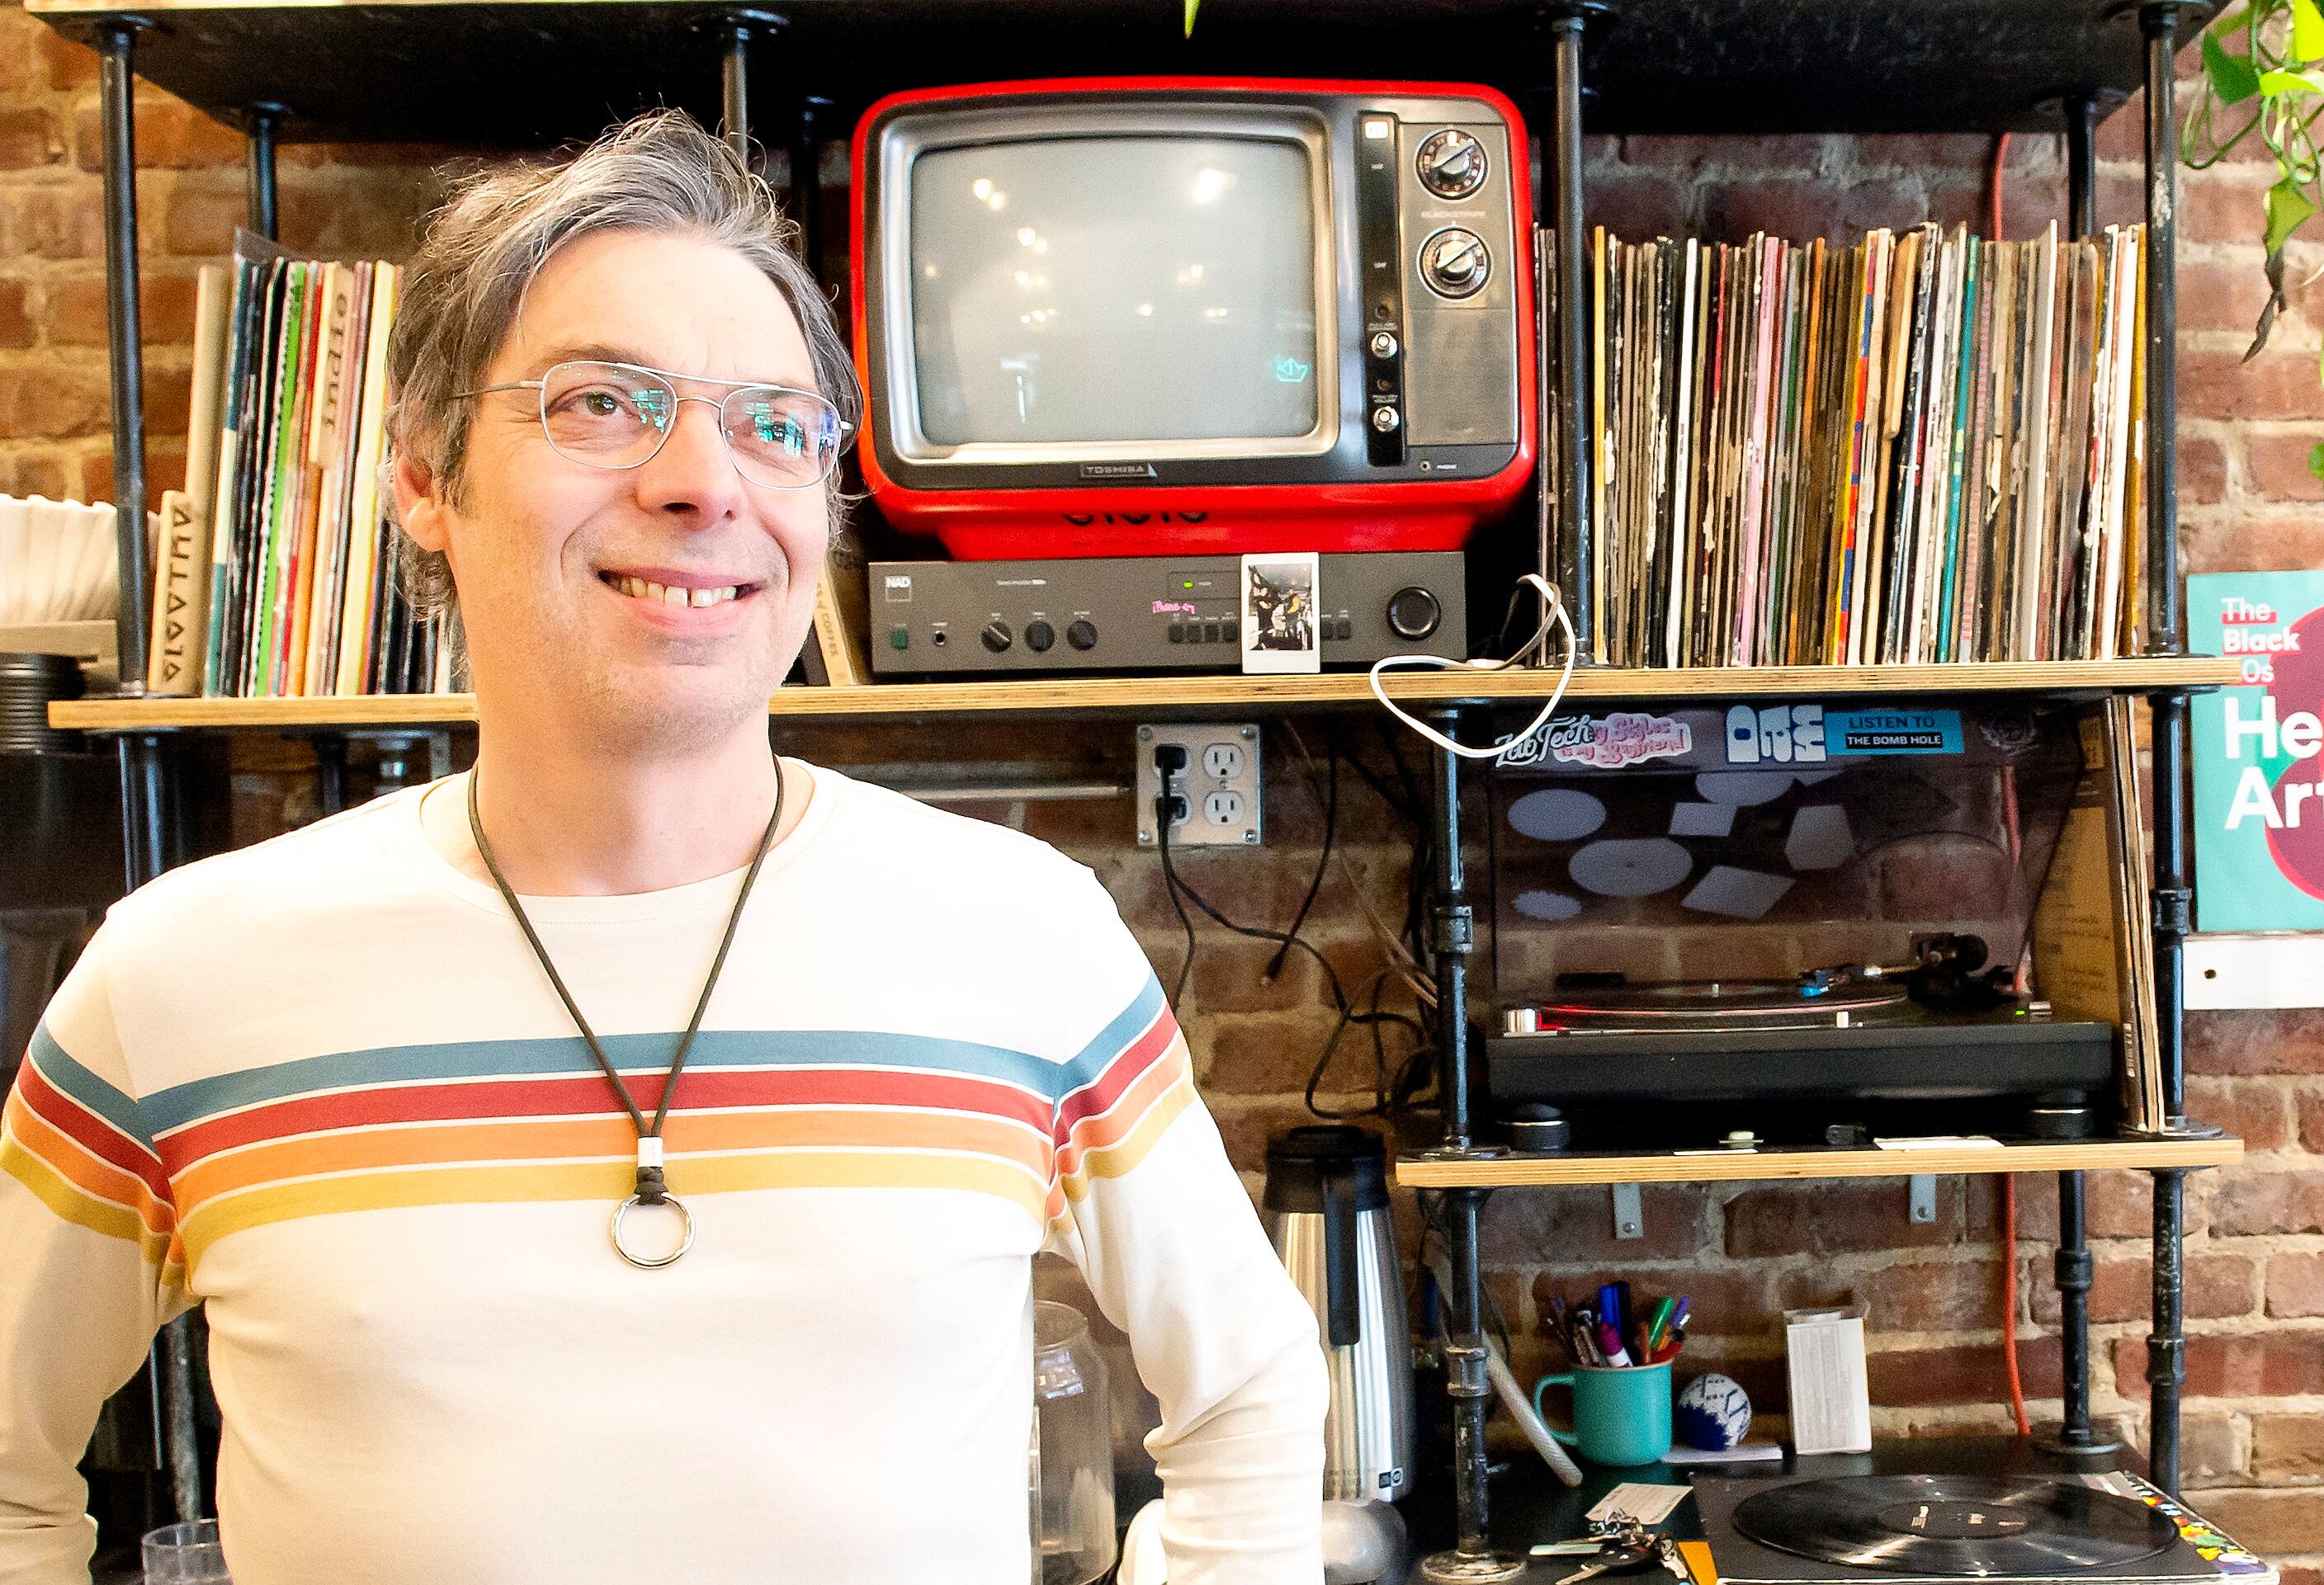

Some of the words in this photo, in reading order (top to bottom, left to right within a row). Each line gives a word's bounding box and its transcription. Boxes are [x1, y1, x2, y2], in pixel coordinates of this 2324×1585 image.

[1086, 465, 1145, 474] TOSHIBA
[886, 576, 911, 587] NAD
[2222, 597, 2272, 621] The
[2223, 626, 2301, 653] Black
[1849, 715, 1909, 729] LISTEN
[1913, 715, 1935, 728] TO
[2225, 696, 2323, 759] He
[1848, 736, 1871, 745] THE
[1873, 735, 1907, 745] BOMB
[1910, 734, 1941, 745] HOLE
